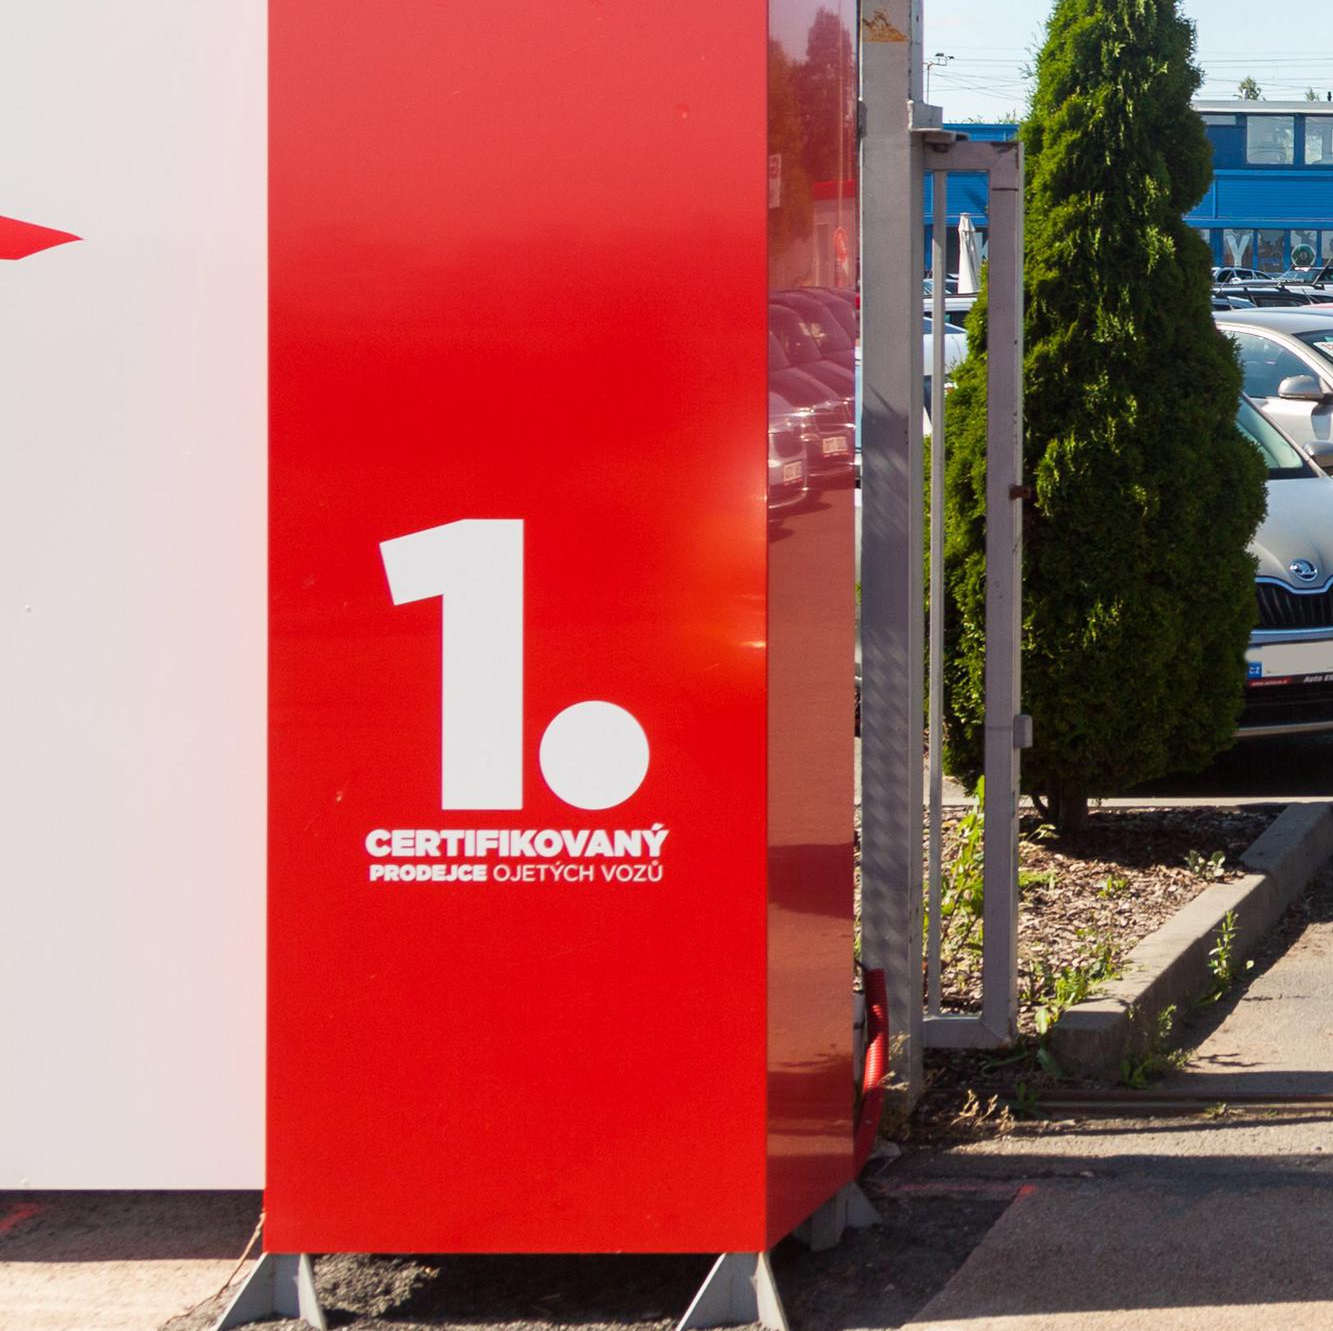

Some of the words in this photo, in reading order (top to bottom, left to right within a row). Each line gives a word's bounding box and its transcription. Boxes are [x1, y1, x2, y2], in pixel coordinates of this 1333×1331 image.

[378, 518, 650, 810] 1.
[1303, 675, 1323, 684] Auto
[365, 823, 669, 858] CERTIFIKOVANÝ
[369, 864, 487, 882] PRODEJCE
[493, 860, 595, 882] OJETÝCH
[601, 860, 663, 882] VOZŮ
